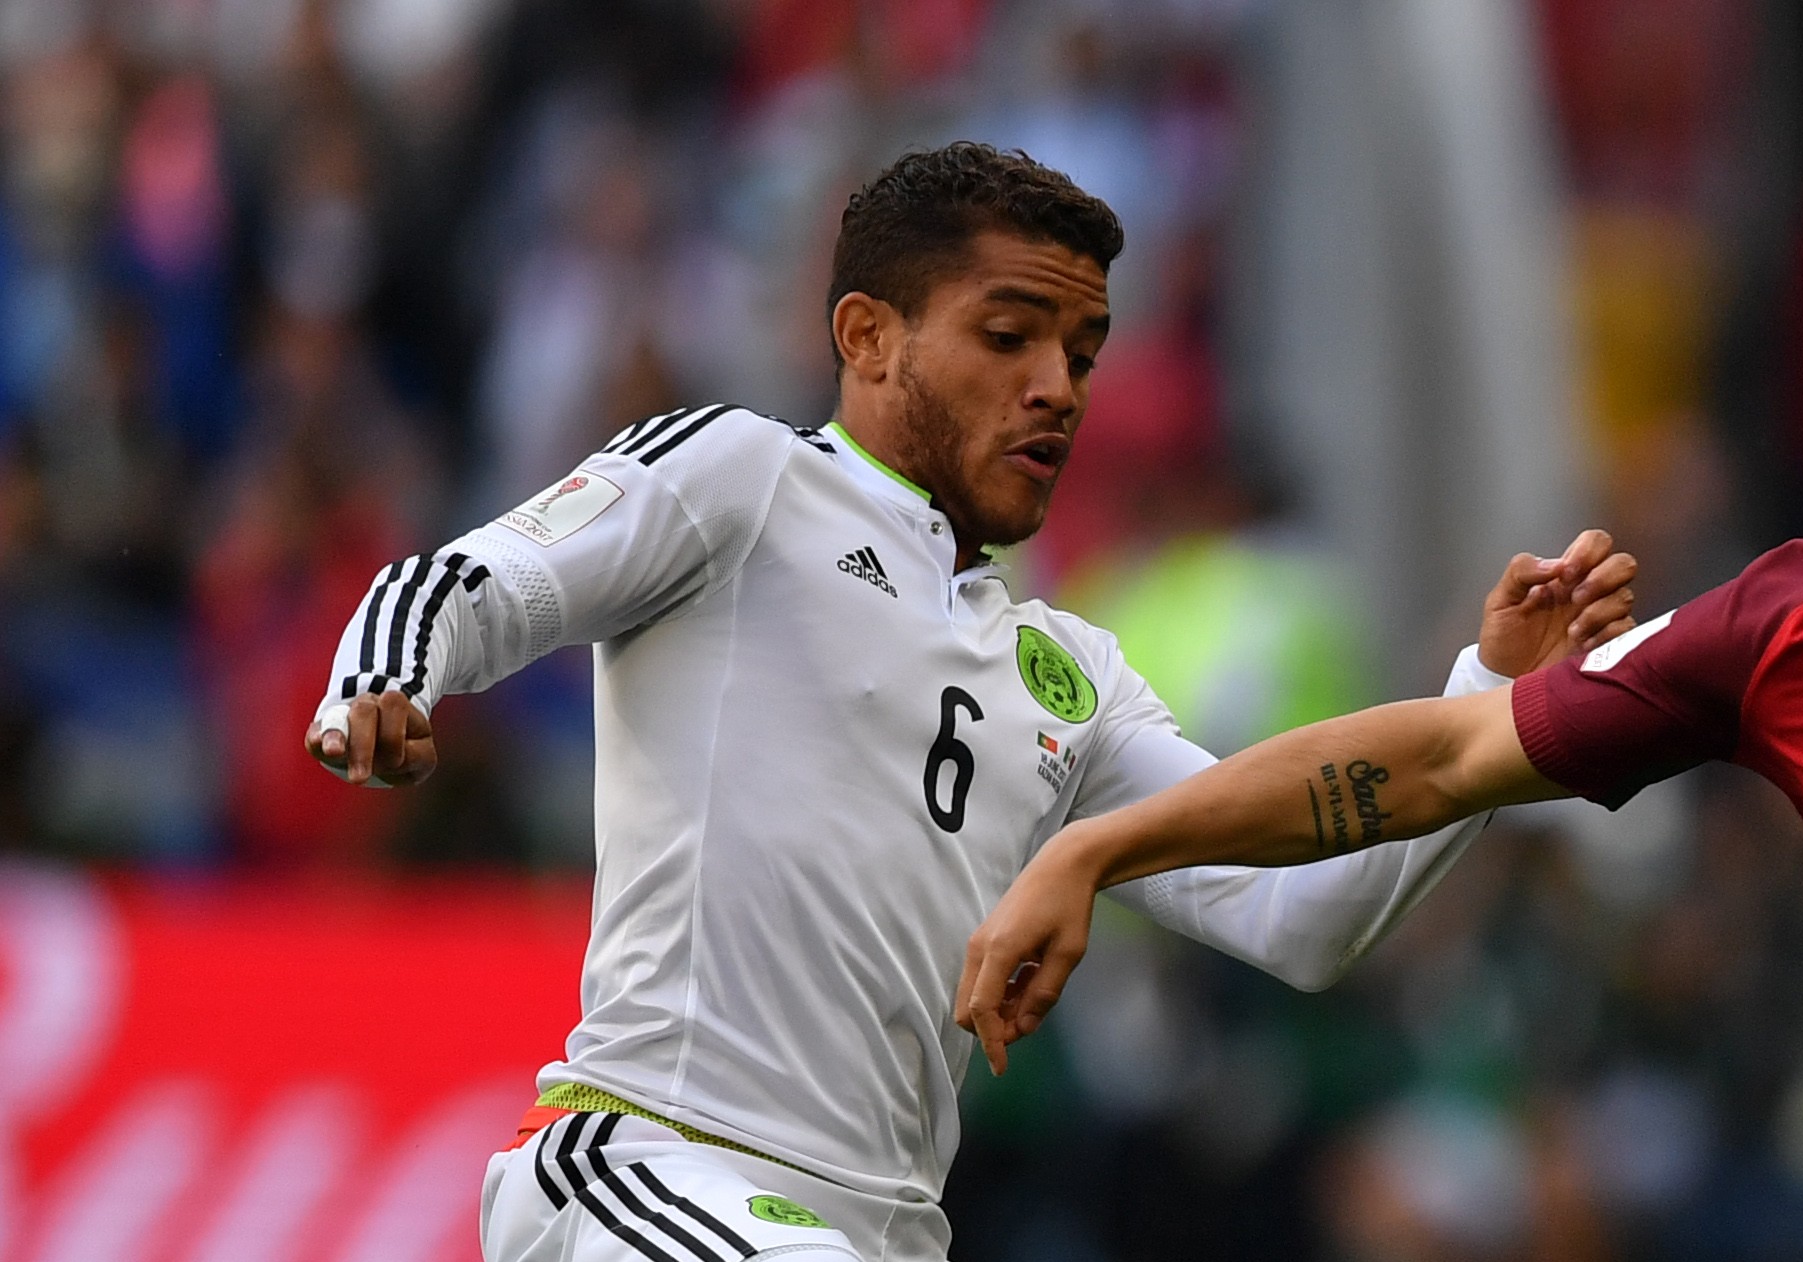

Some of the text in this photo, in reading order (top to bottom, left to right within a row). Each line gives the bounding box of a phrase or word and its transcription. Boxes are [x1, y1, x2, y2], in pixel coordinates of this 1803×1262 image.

[525, 521, 554, 541] 2017
[837, 559, 898, 598] adidas
[923, 685, 985, 834] 6
